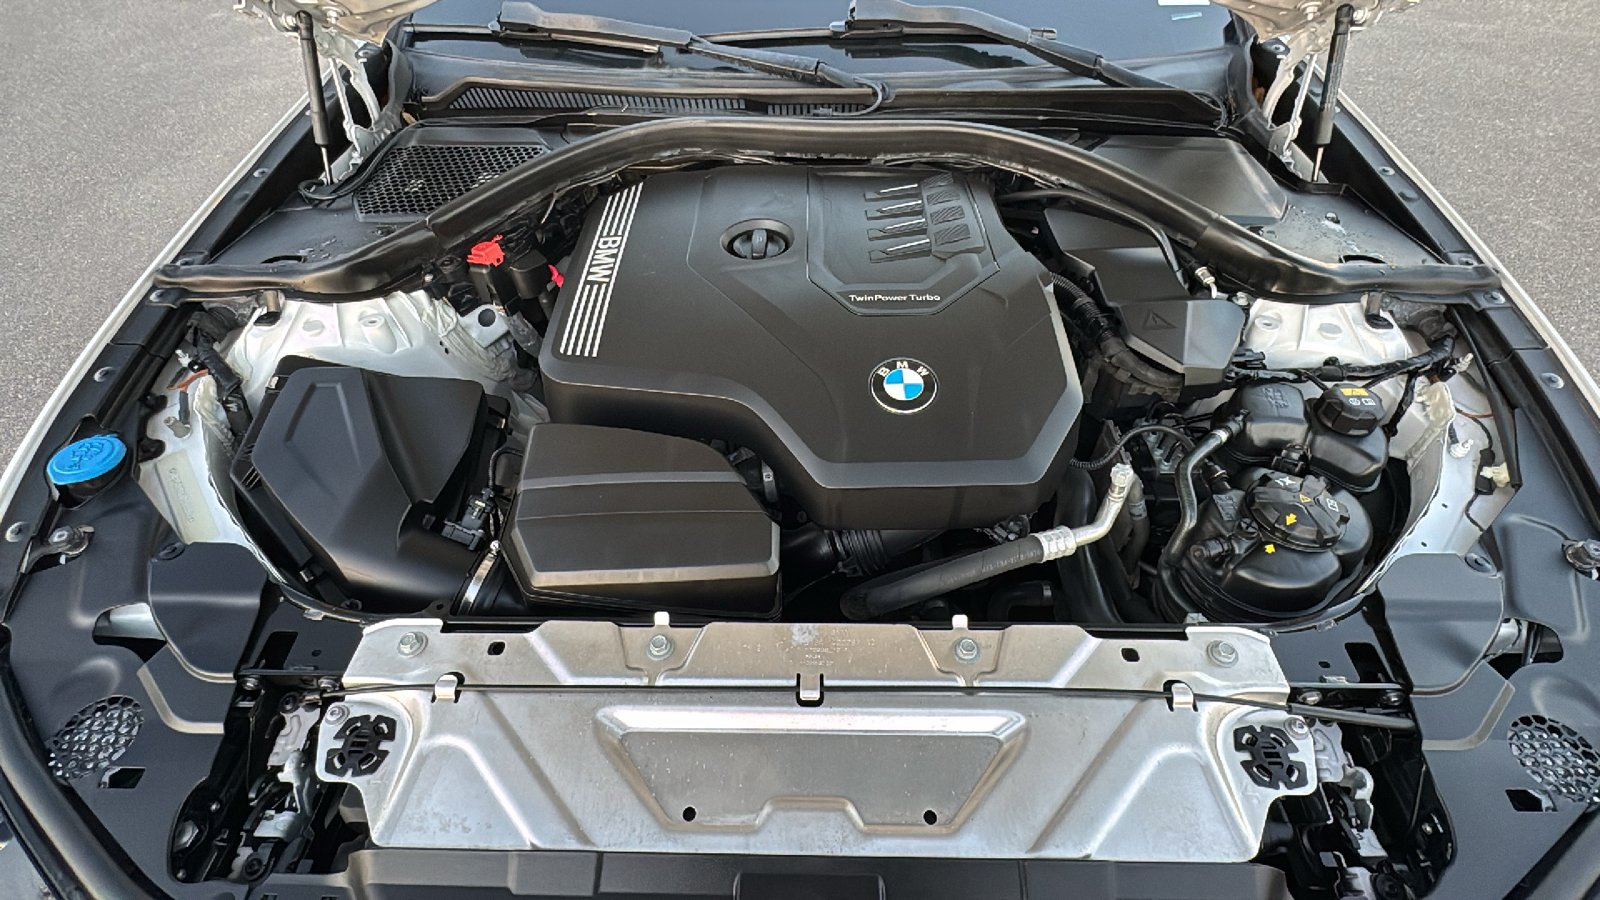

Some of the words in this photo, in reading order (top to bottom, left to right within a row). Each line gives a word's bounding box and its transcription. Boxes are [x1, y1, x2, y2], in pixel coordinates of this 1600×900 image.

[587, 236, 622, 282] BMW
[848, 294, 908, 302] TwinPower
[908, 293, 941, 301] Turbo
[876, 360, 930, 377] BMW
